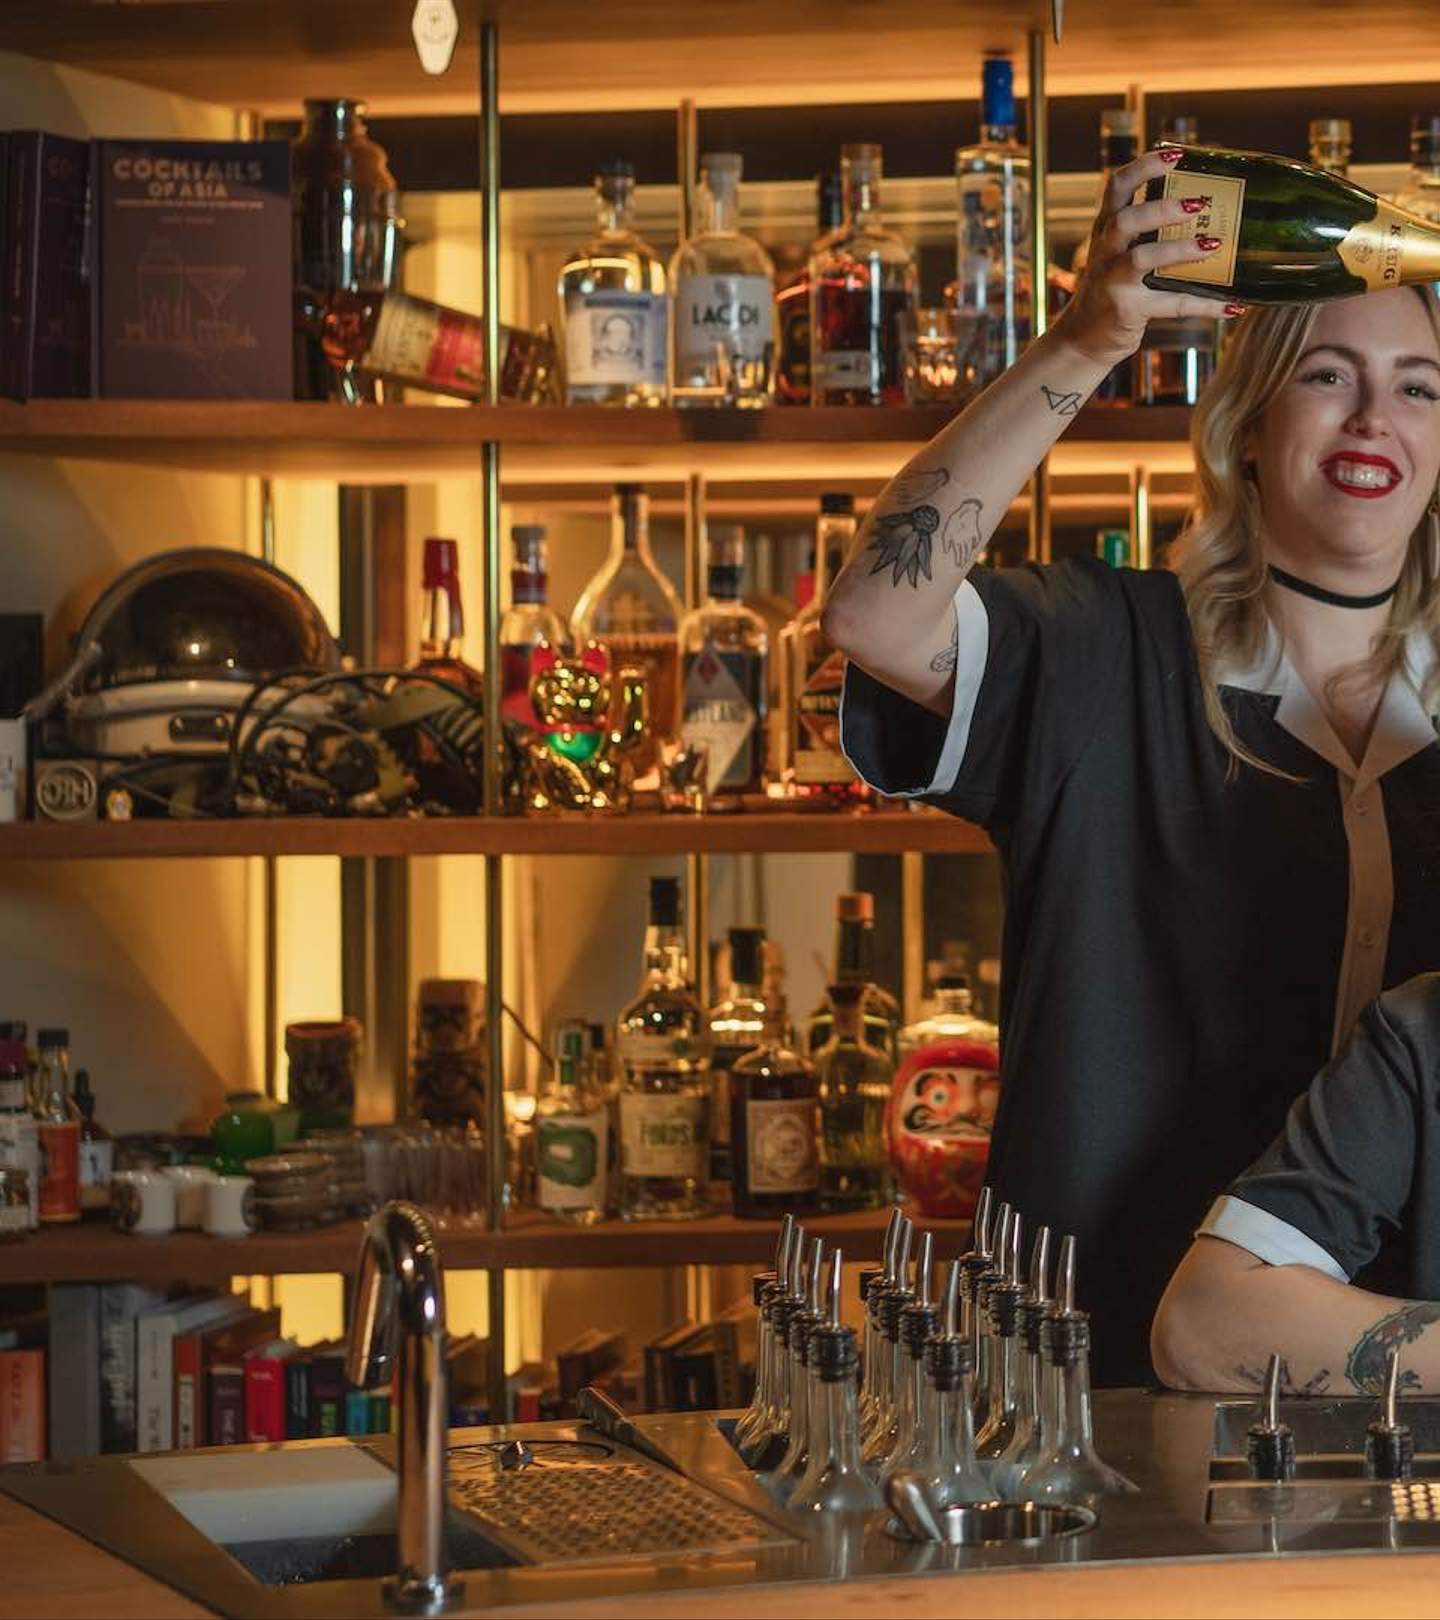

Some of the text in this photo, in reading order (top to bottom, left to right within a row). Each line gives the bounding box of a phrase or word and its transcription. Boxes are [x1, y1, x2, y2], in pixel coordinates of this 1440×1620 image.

[113, 157, 263, 182] COCKTAILS
[148, 182, 229, 198] OF ASIA
[692, 302, 760, 326] LACDI
